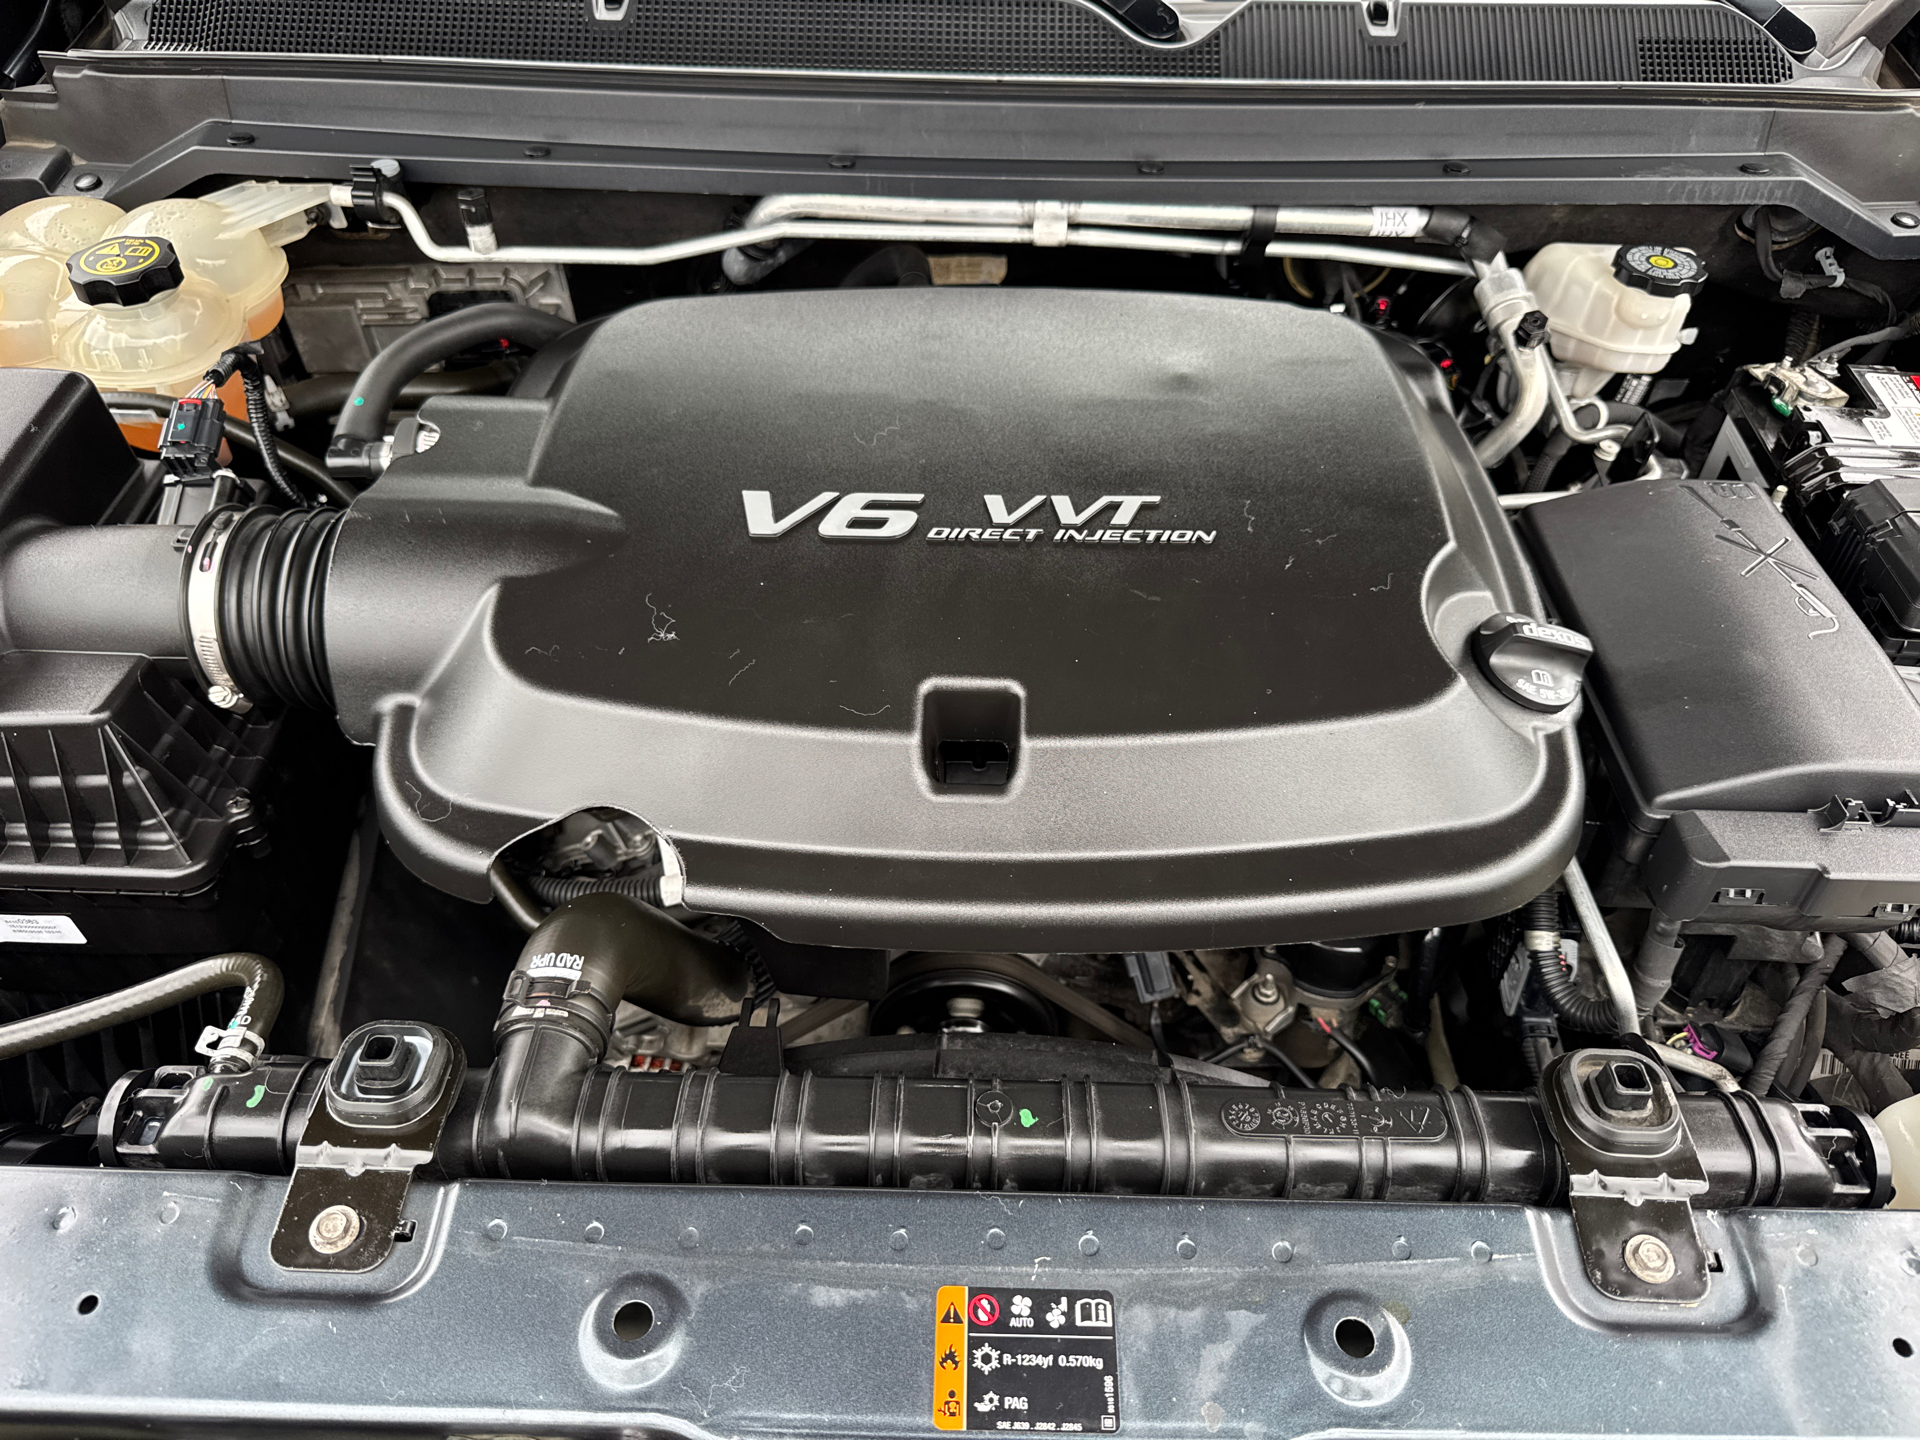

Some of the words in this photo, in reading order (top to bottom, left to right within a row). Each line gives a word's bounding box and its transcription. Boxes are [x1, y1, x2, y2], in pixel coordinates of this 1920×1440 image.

[741, 489, 925, 540] V6
[983, 494, 1162, 527] VVT
[926, 528, 1045, 544] DIRECT
[1052, 529, 1217, 546] INJECTION
[1522, 622, 1588, 649] dexos
[1516, 678, 1538, 696] SAE
[530, 952, 556, 969] UPR
[556, 952, 585, 971] RAD
[1009, 1317, 1034, 1328] AUTO
[1002, 1354, 1053, 1369] R-1234yf
[1058, 1355, 1104, 1370] 0.570kg
[1003, 1396, 1029, 1410] PAG
[996, 1420, 1012, 1430] SAE
